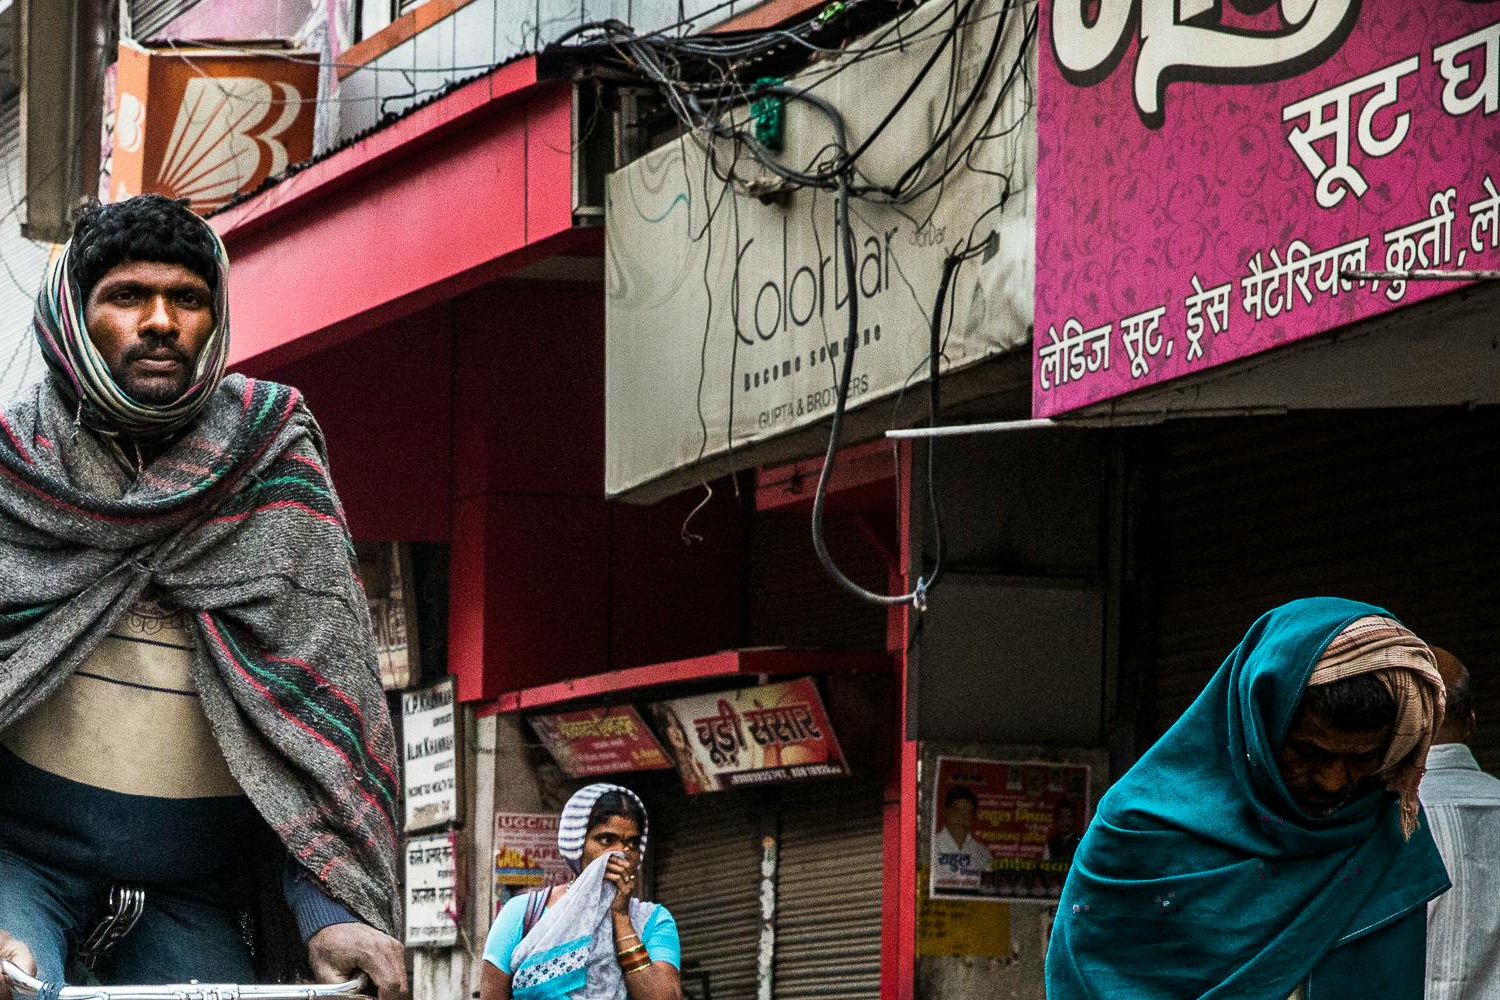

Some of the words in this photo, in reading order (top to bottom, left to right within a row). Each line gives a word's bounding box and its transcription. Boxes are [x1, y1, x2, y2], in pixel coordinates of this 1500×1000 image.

[1283, 56, 1419, 208] सूट
[1432, 21, 1500, 116] घ
[1039, 319, 1112, 390] लेडिज
[1120, 307, 1173, 378] सूट,
[1185, 275, 1232, 361] ड्रेस
[807, 374, 869, 413] BROTERS
[693, 699, 746, 766] चूड़ी
[743, 699, 821, 745] संसार
